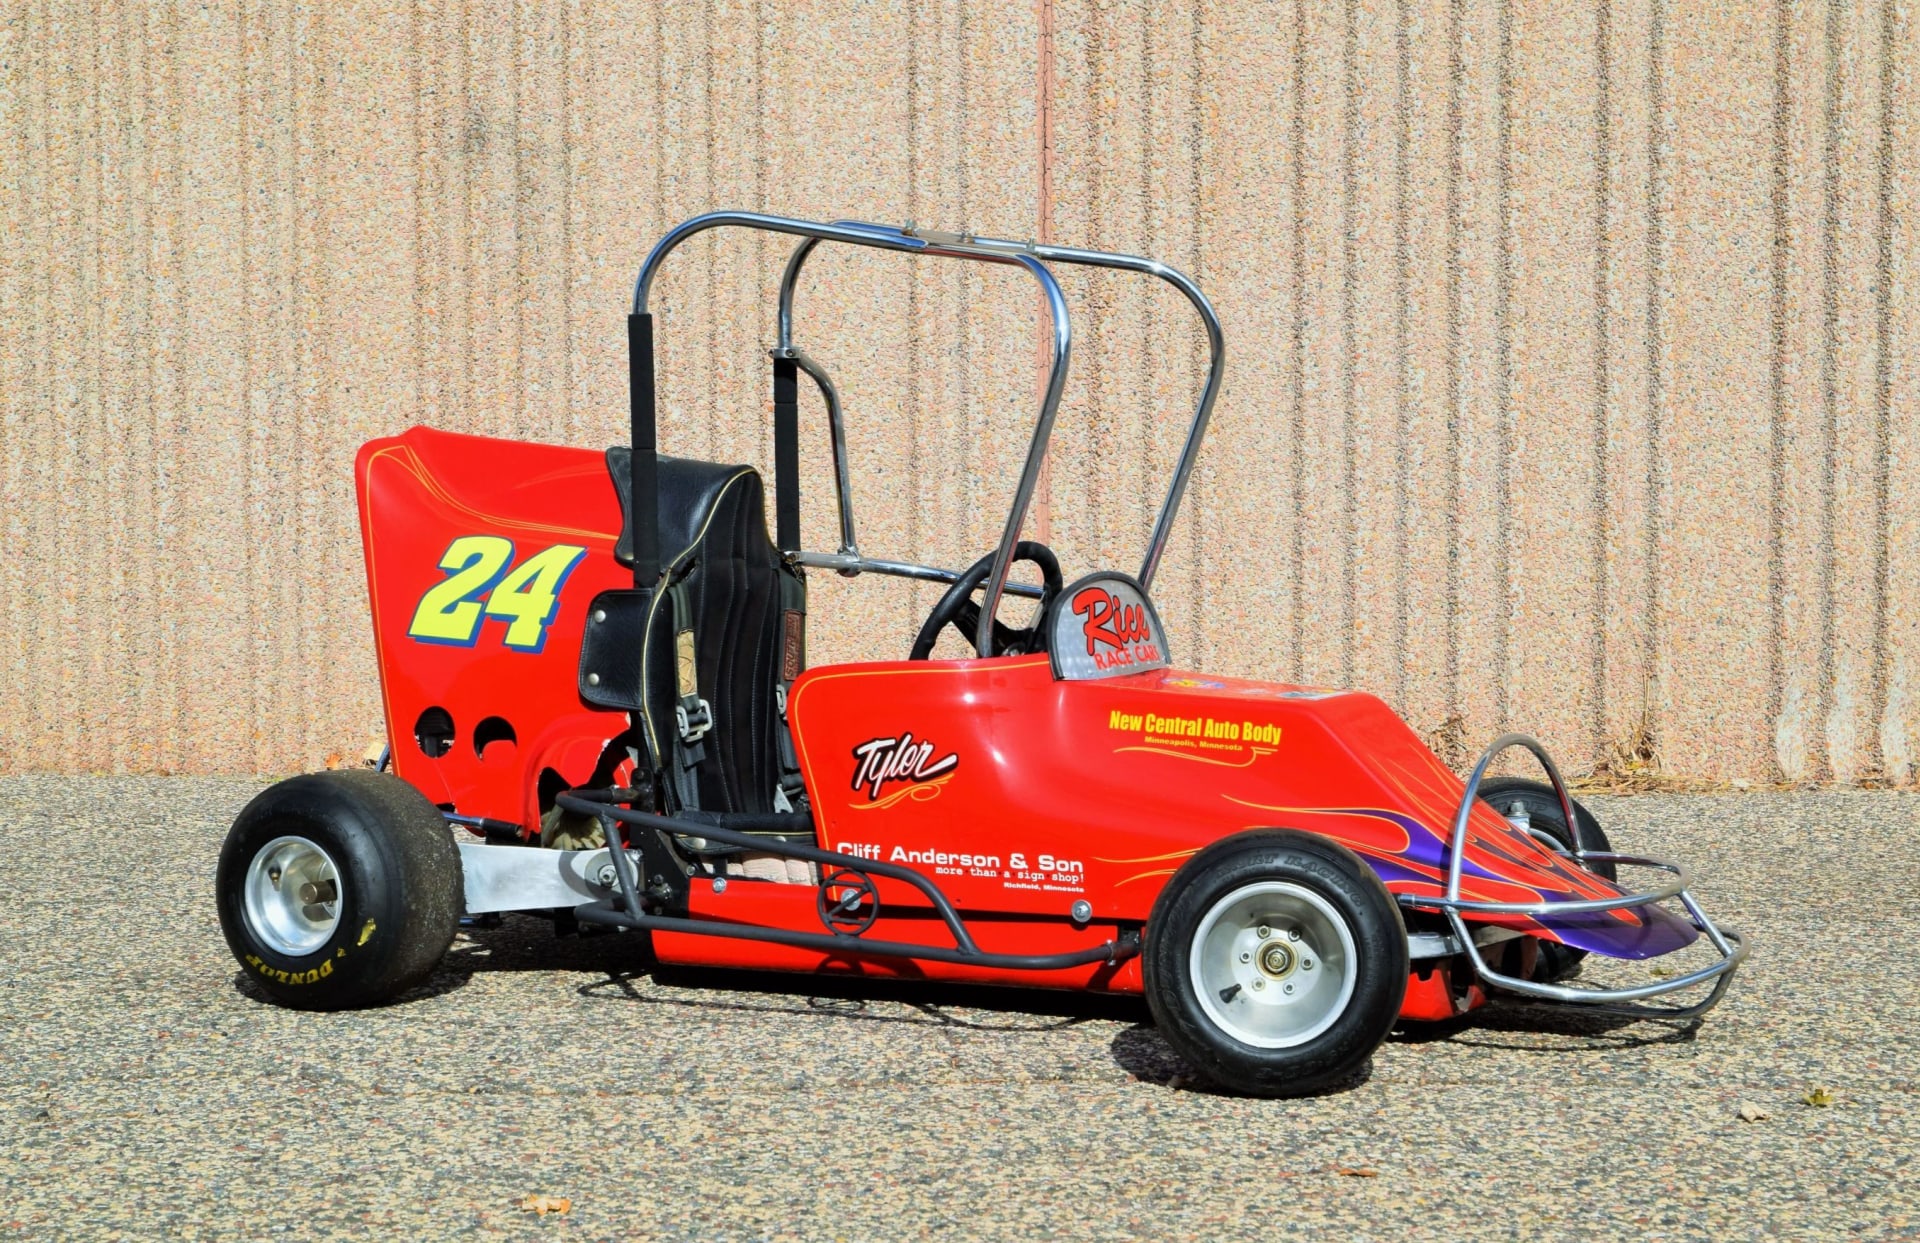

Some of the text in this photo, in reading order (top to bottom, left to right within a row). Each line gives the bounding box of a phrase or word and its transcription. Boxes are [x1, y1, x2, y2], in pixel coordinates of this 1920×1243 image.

[406, 534, 588, 655] 24
[1072, 586, 1150, 656] Rice
[1094, 647, 1134, 671] RACE
[1109, 710, 1282, 746] New Central Auto Body
[1144, 736, 1243, 751] Minneapolis, Minnesota
[851, 732, 958, 801] Tyler
[837, 841, 1083, 873] Cliff Anderson & Son
[935, 866, 1084, 884] more than a sign shop!
[1003, 881, 1085, 893] Richfield, Minnesota
[1284, 855, 1363, 908] RACING
[245, 954, 334, 985] DUNLOP
